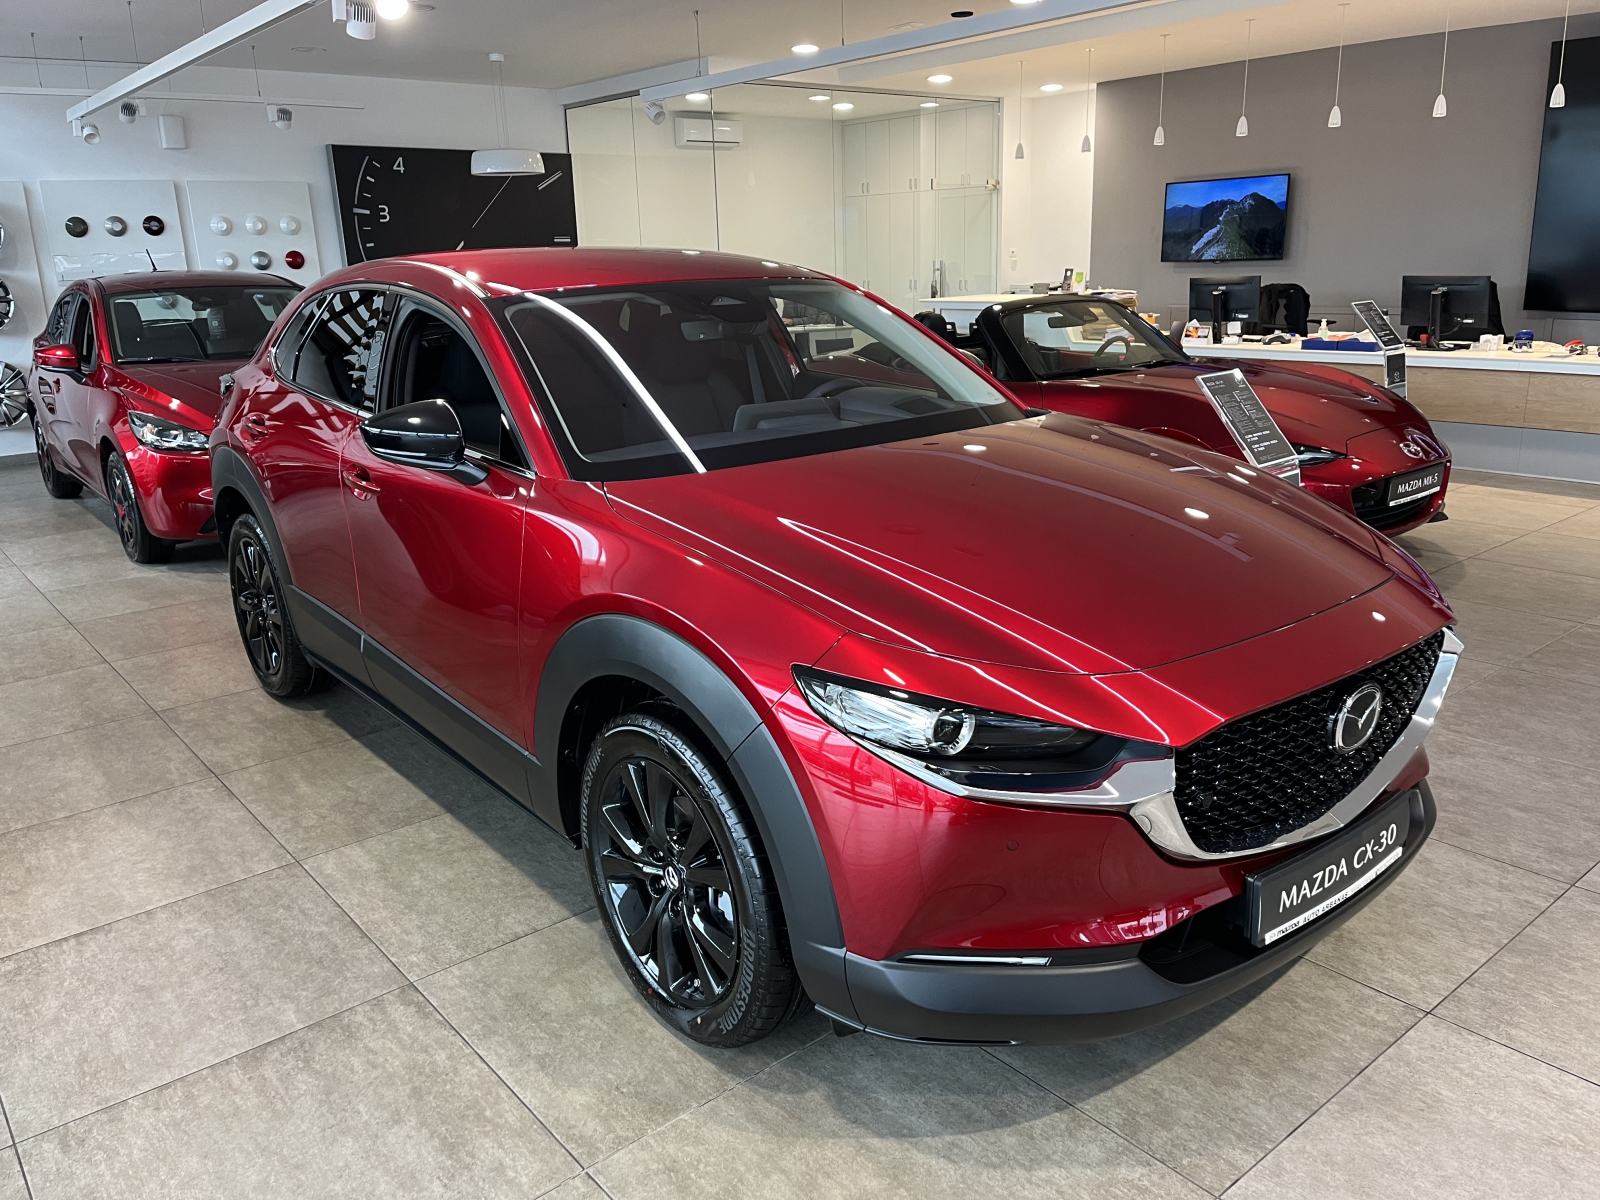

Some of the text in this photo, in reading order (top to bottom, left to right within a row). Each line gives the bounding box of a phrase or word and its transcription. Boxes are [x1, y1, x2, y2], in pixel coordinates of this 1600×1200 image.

[393, 156, 405, 174] 4
[377, 205, 390, 222] 3
[1397, 473, 1438, 494] MAZDA MX-5
[1279, 858, 1348, 913] MAZDA
[1353, 823, 1397, 868] CX-30
[1303, 909, 1320, 923] AUTO
[717, 926, 756, 1035] BRIDGESTONE
